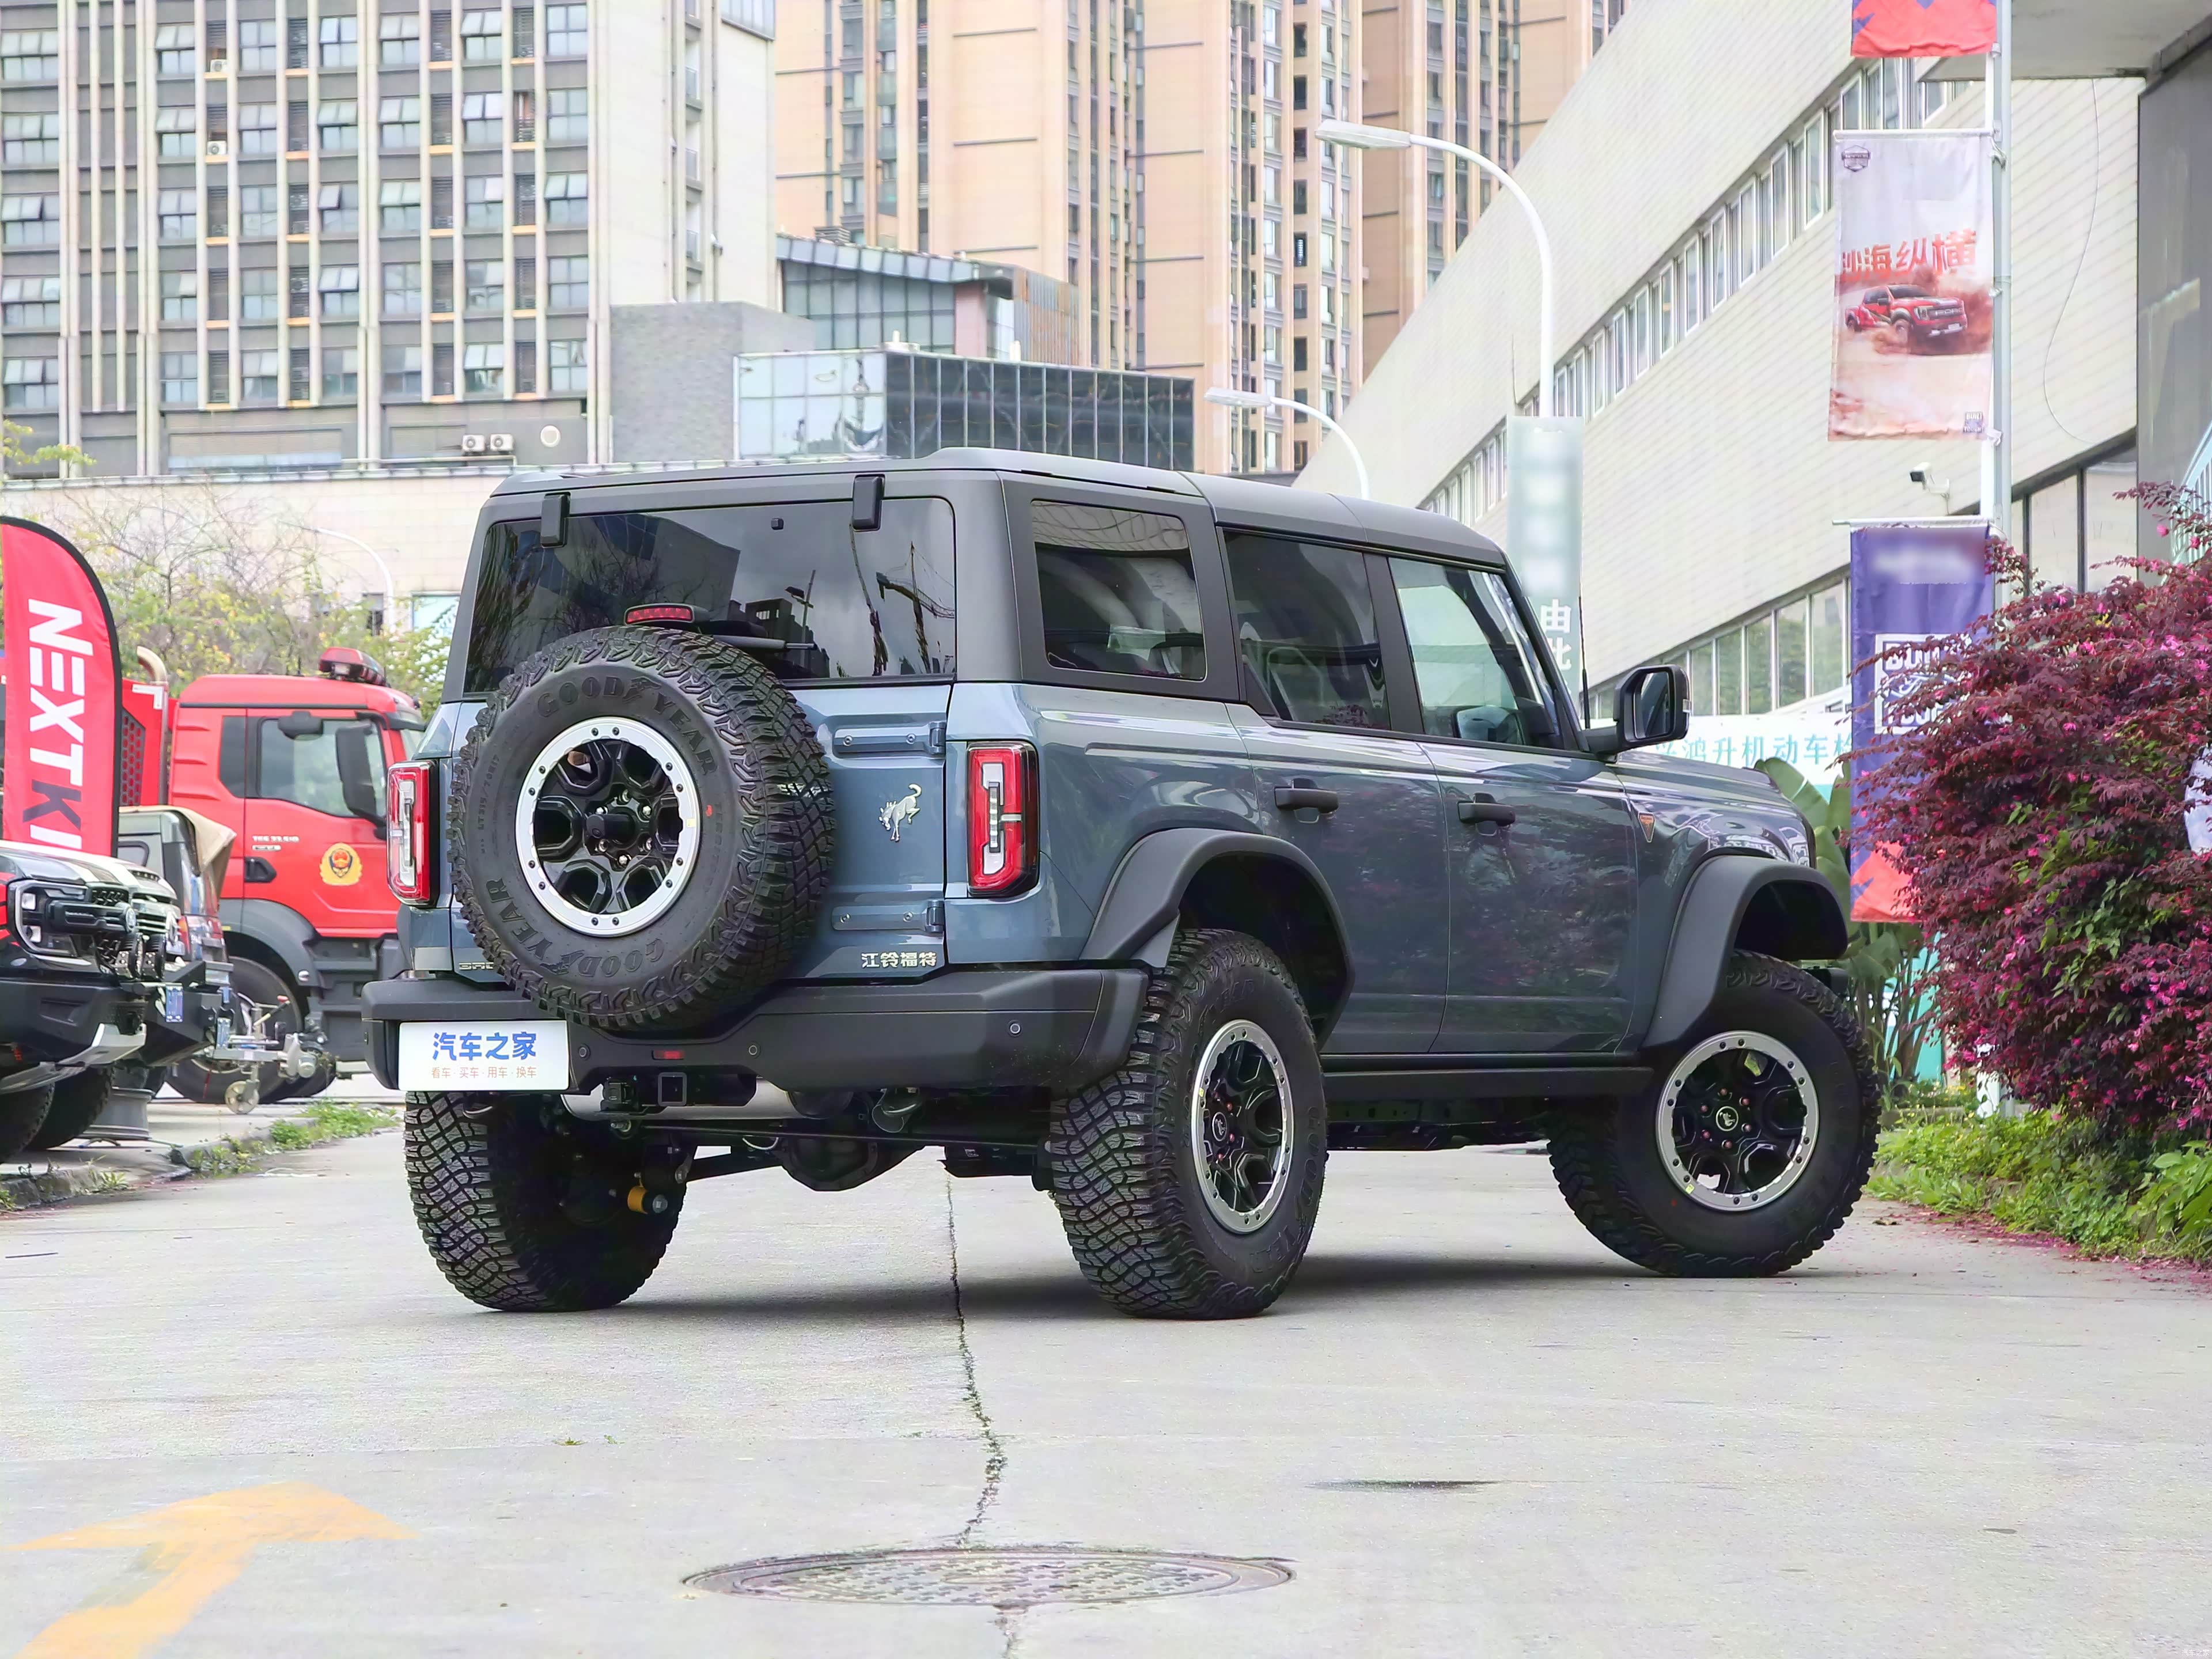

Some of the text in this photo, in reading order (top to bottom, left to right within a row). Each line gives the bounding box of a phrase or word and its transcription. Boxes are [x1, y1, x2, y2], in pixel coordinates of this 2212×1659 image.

[1840, 228, 1976, 281] 沙海纵横
[861, 952, 937, 968] 江铃福特
[433, 1032, 537, 1060] 汽车之家
